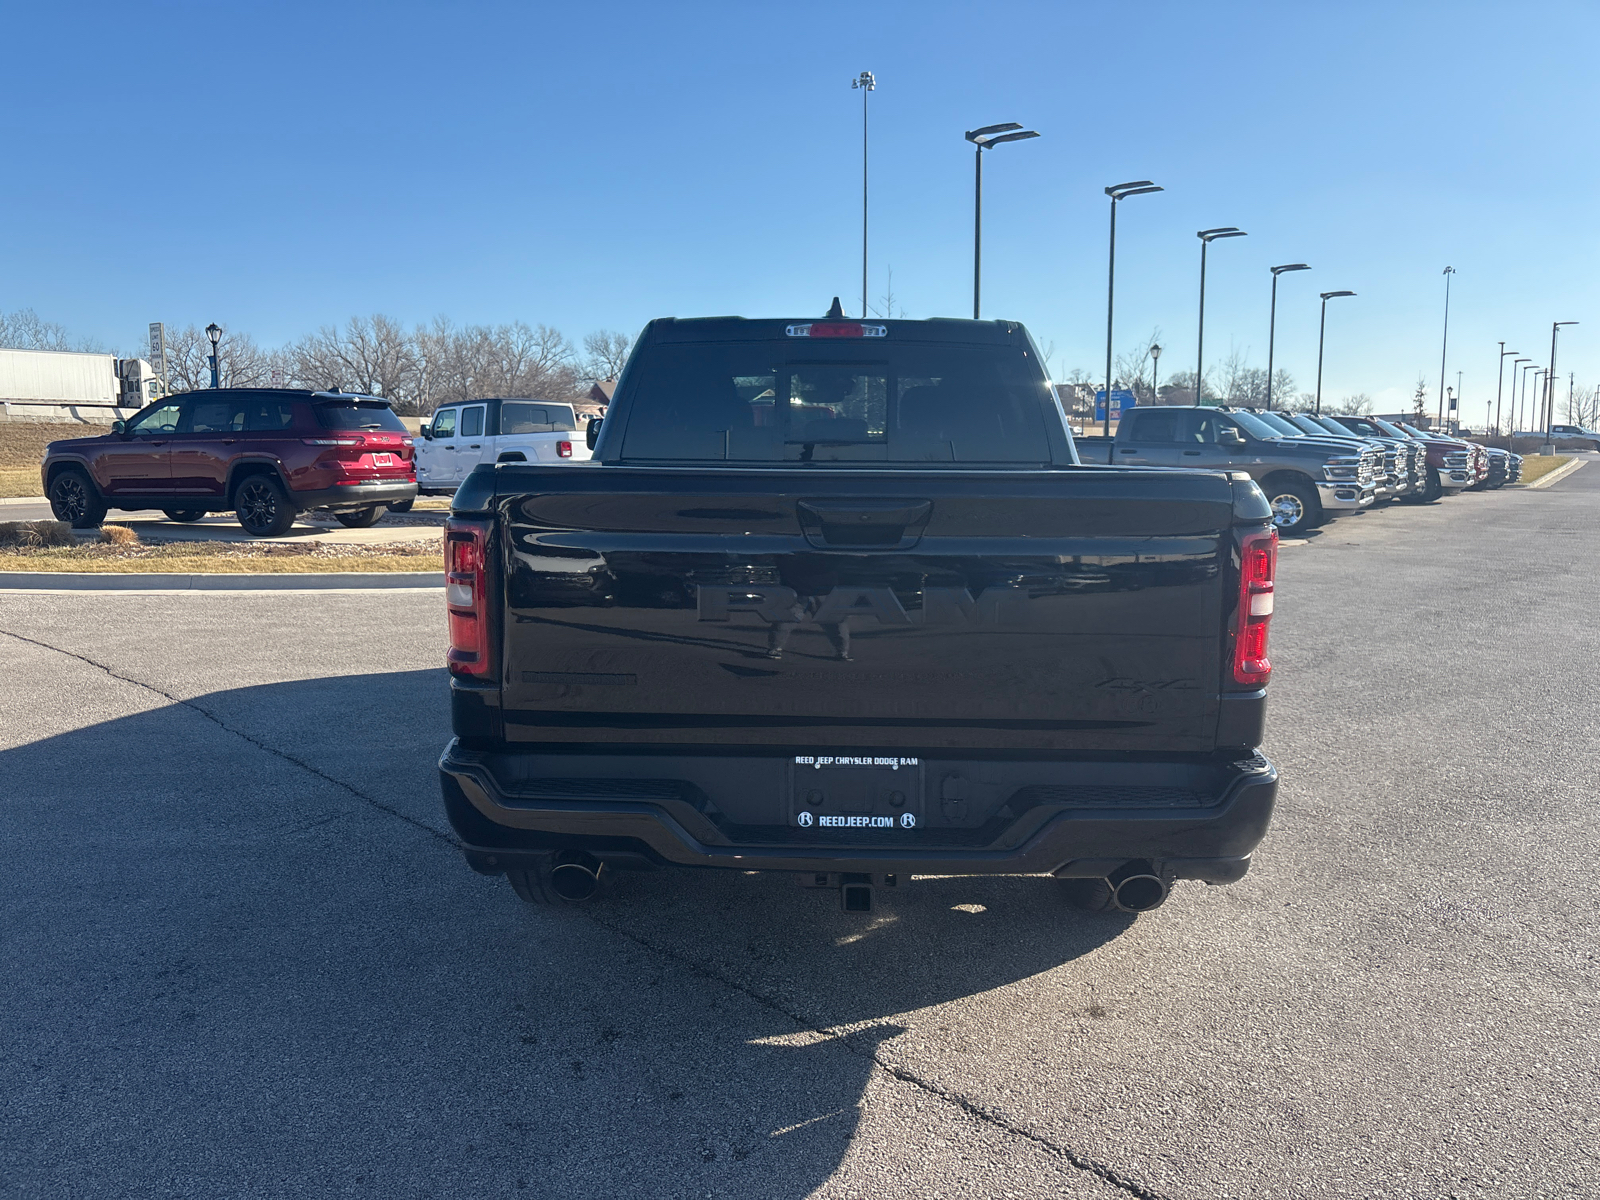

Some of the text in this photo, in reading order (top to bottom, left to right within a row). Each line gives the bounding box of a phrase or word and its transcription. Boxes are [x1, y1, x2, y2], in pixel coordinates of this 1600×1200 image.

[697, 585, 1029, 625] RAM
[795, 756, 918, 766] REED JEEP CHRYSLER DODGE RAM
[819, 816, 894, 828] REEDJEEP.COM
